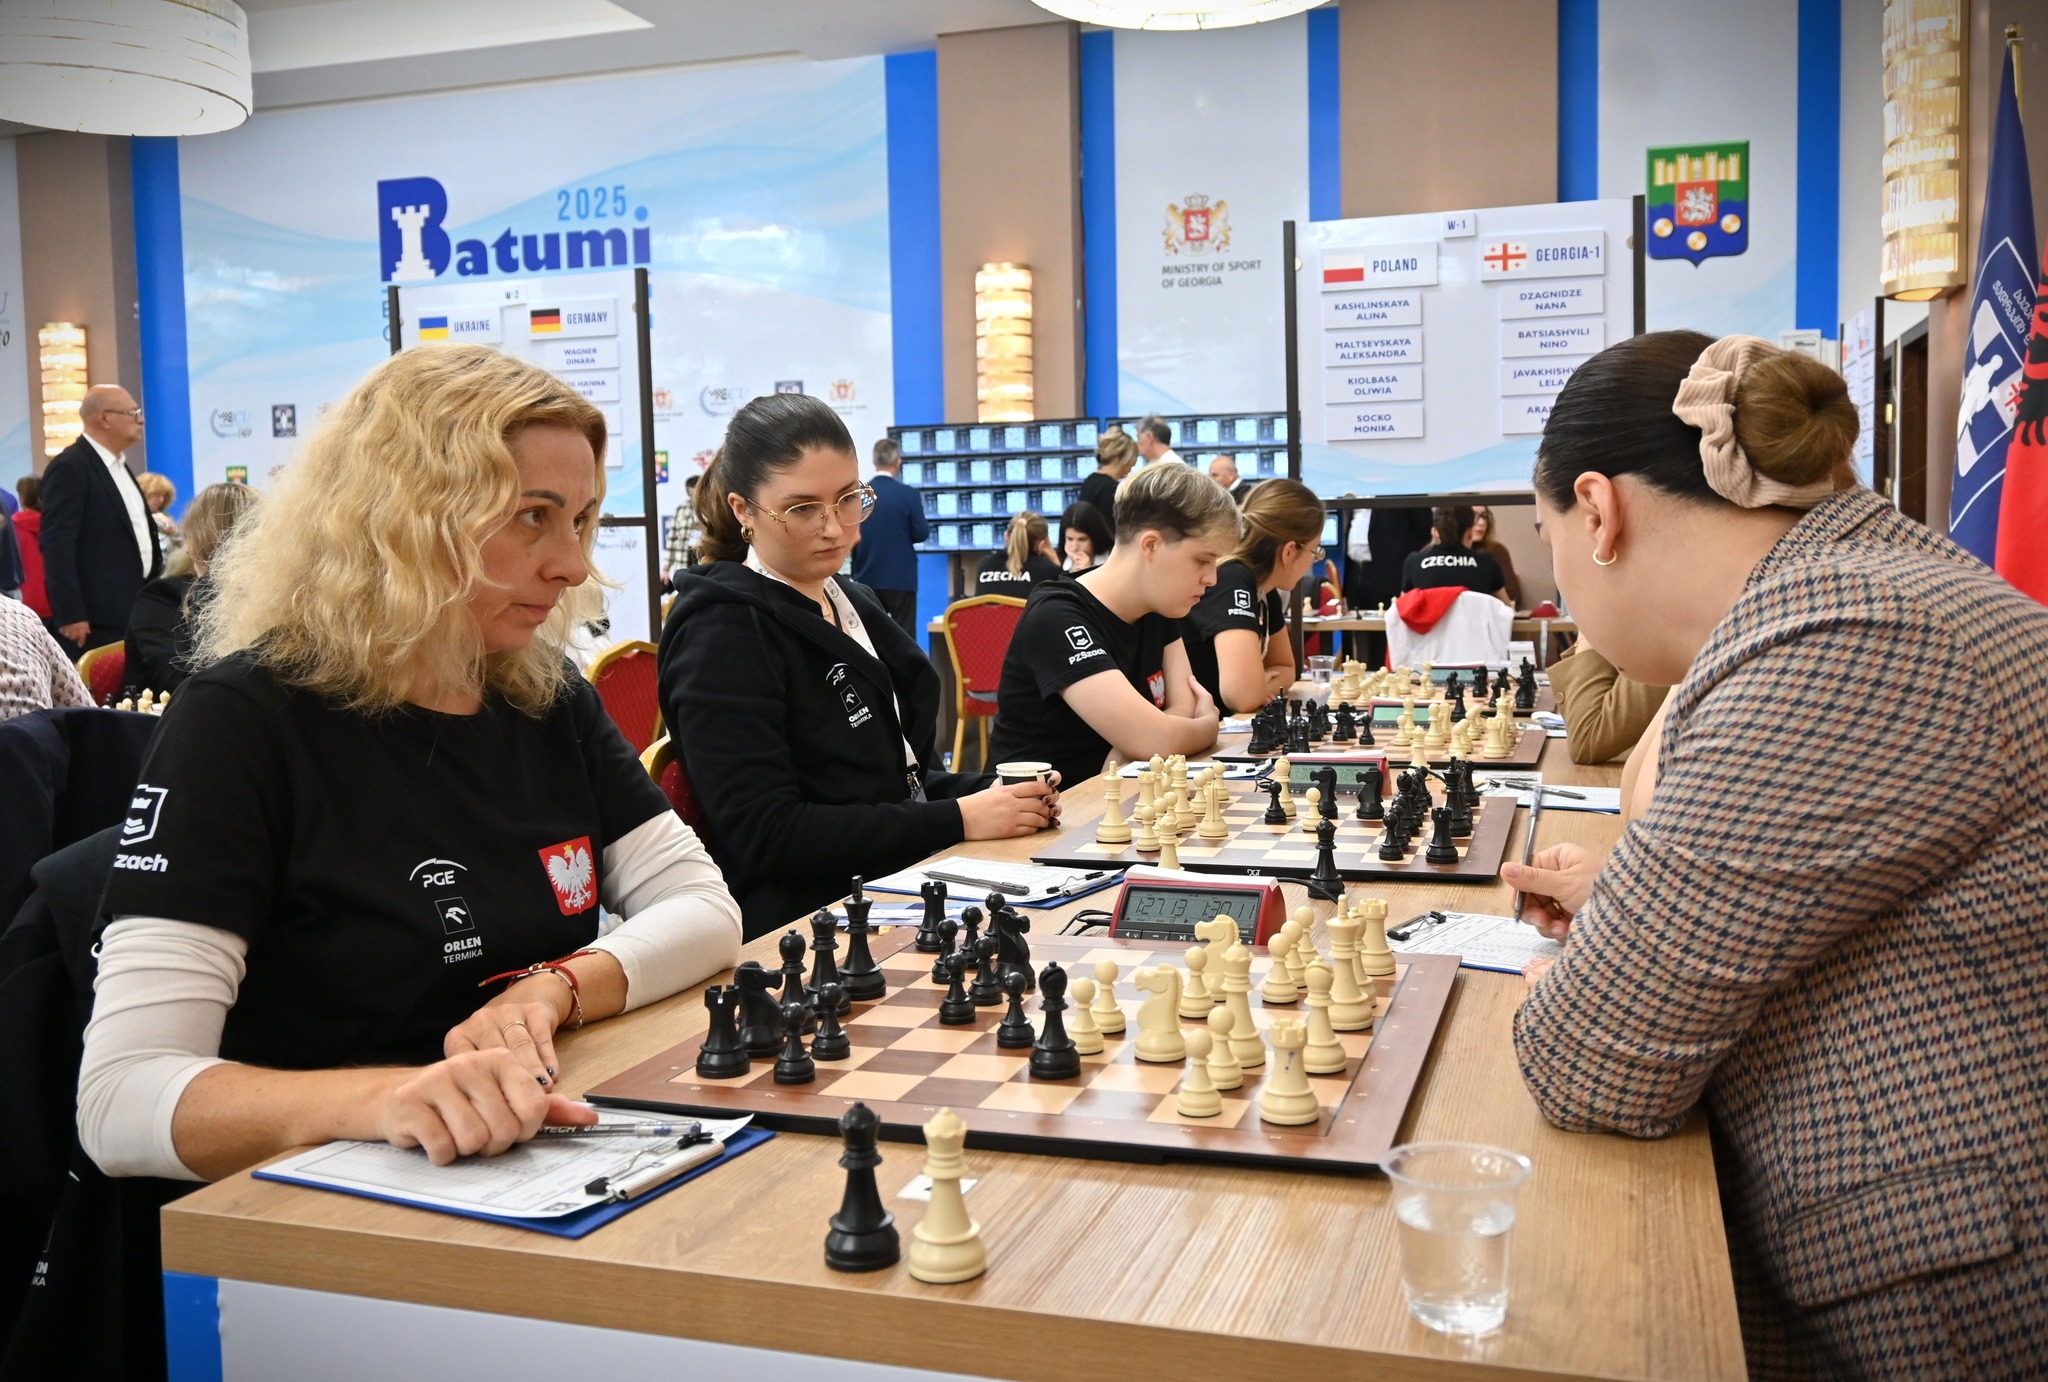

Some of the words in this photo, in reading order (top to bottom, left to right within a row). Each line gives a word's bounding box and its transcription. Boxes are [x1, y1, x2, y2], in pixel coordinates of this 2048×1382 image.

[557, 185, 627, 221] 2025
[376, 176, 651, 282] Batumi
[1447, 219, 1466, 230] W-1
[1536, 245, 1600, 262] GEORGIA-1
[1162, 262, 1210, 275] MINISTRY
[1212, 261, 1225, 272] OF
[1228, 259, 1262, 271] SPORT
[1372, 257, 1418, 273] POLAND
[1162, 278, 1174, 289] OF
[1177, 275, 1223, 288] GEORGIA
[1520, 288, 1582, 301] DZAGNIDZE
[1334, 299, 1410, 310] KASHLINSKAYA
[1535, 301, 1567, 311] NANA
[567, 312, 608, 325] GERMANY
[1356, 312, 1388, 321] ALINA
[454, 320, 490, 333] UKRAINE
[1518, 327, 1590, 339] BATSIASHVILI
[1335, 338, 1412, 349] MALTSEVSKAYA
[1540, 340, 1568, 349] NINO
[564, 347, 597, 356] WAGNER
[1340, 349, 1407, 360] ALEKSANDRA
[1347, 375, 1398, 385] KIOLBASA
[1539, 378, 1565, 388] LELA
[1354, 386, 1392, 396] OLIWIA
[1356, 413, 1392, 422] SOCKO
[1354, 425, 1395, 434] MONIKA
[1421, 555, 1478, 569] CZECHIA
[1068, 647, 1107, 665] PZSzach
[422, 870, 456, 888] PGE
[443, 936, 482, 954] ORLEN
[443, 948, 484, 965] TERMIKA
